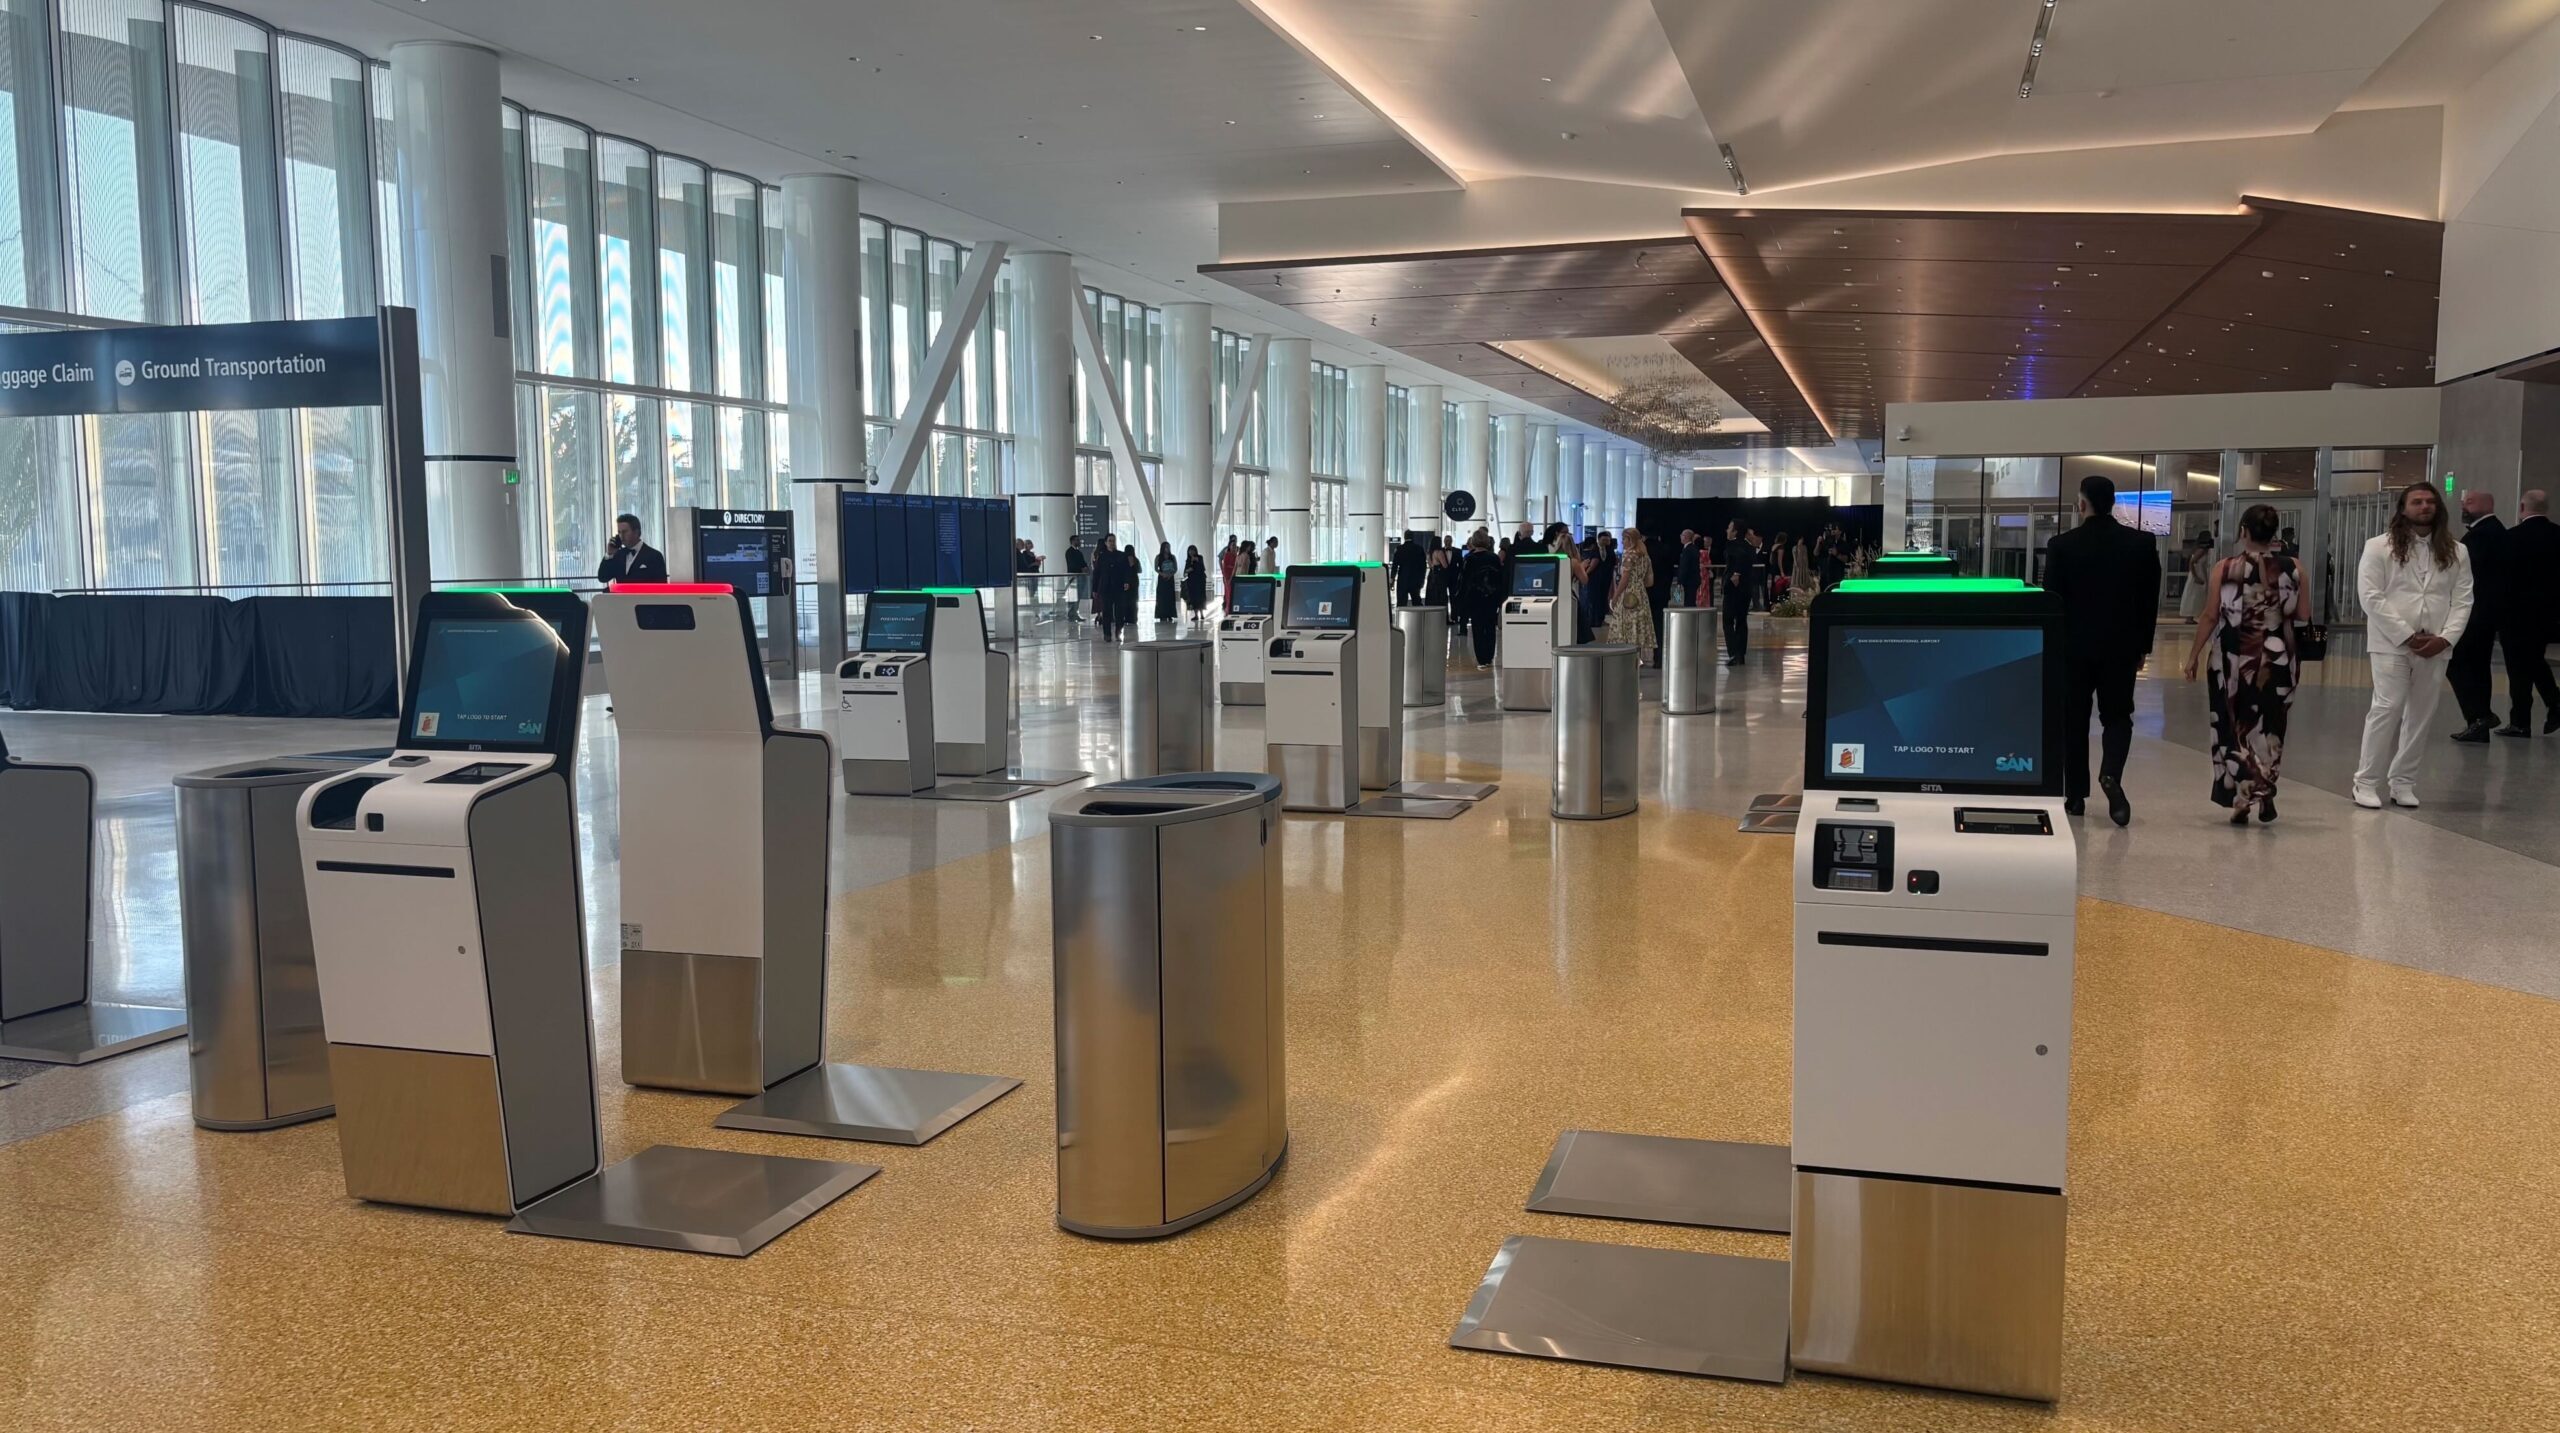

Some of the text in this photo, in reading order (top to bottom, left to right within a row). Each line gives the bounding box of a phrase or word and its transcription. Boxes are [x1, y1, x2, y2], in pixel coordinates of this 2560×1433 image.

[141, 353, 326, 380] Ground Transportation
[0, 362, 94, 389] ggage Claim
[734, 513, 765, 523] DIRECTORY
[518, 722, 542, 734] SAN
[1893, 745, 1909, 753] TAP
[1995, 756, 2033, 772] SAN
[1921, 783, 1943, 792] SITA
